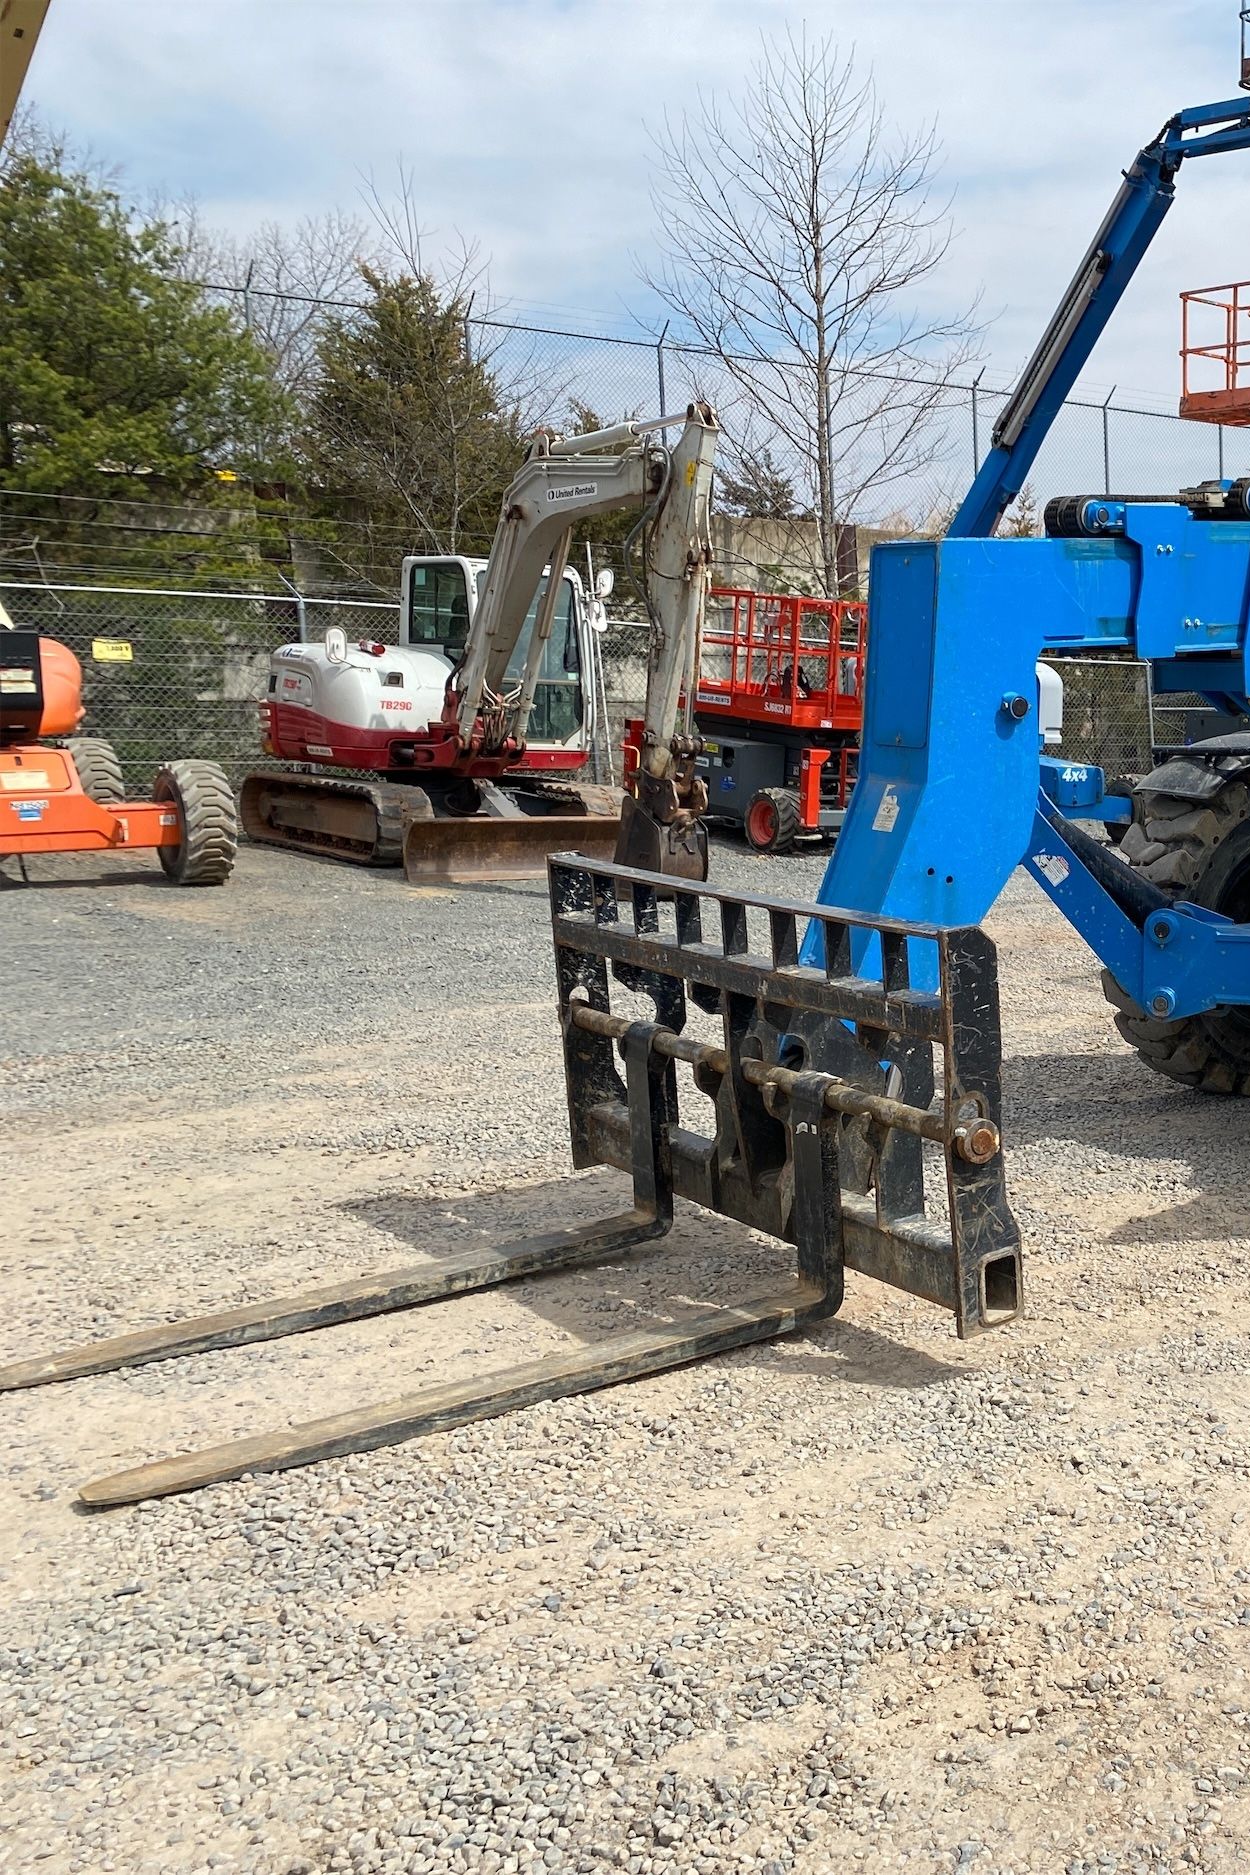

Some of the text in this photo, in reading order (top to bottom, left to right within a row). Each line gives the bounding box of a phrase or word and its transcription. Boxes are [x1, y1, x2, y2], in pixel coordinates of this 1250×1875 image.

[555, 485, 597, 499] United Rentals
[1062, 767, 1088, 782] 4x4
